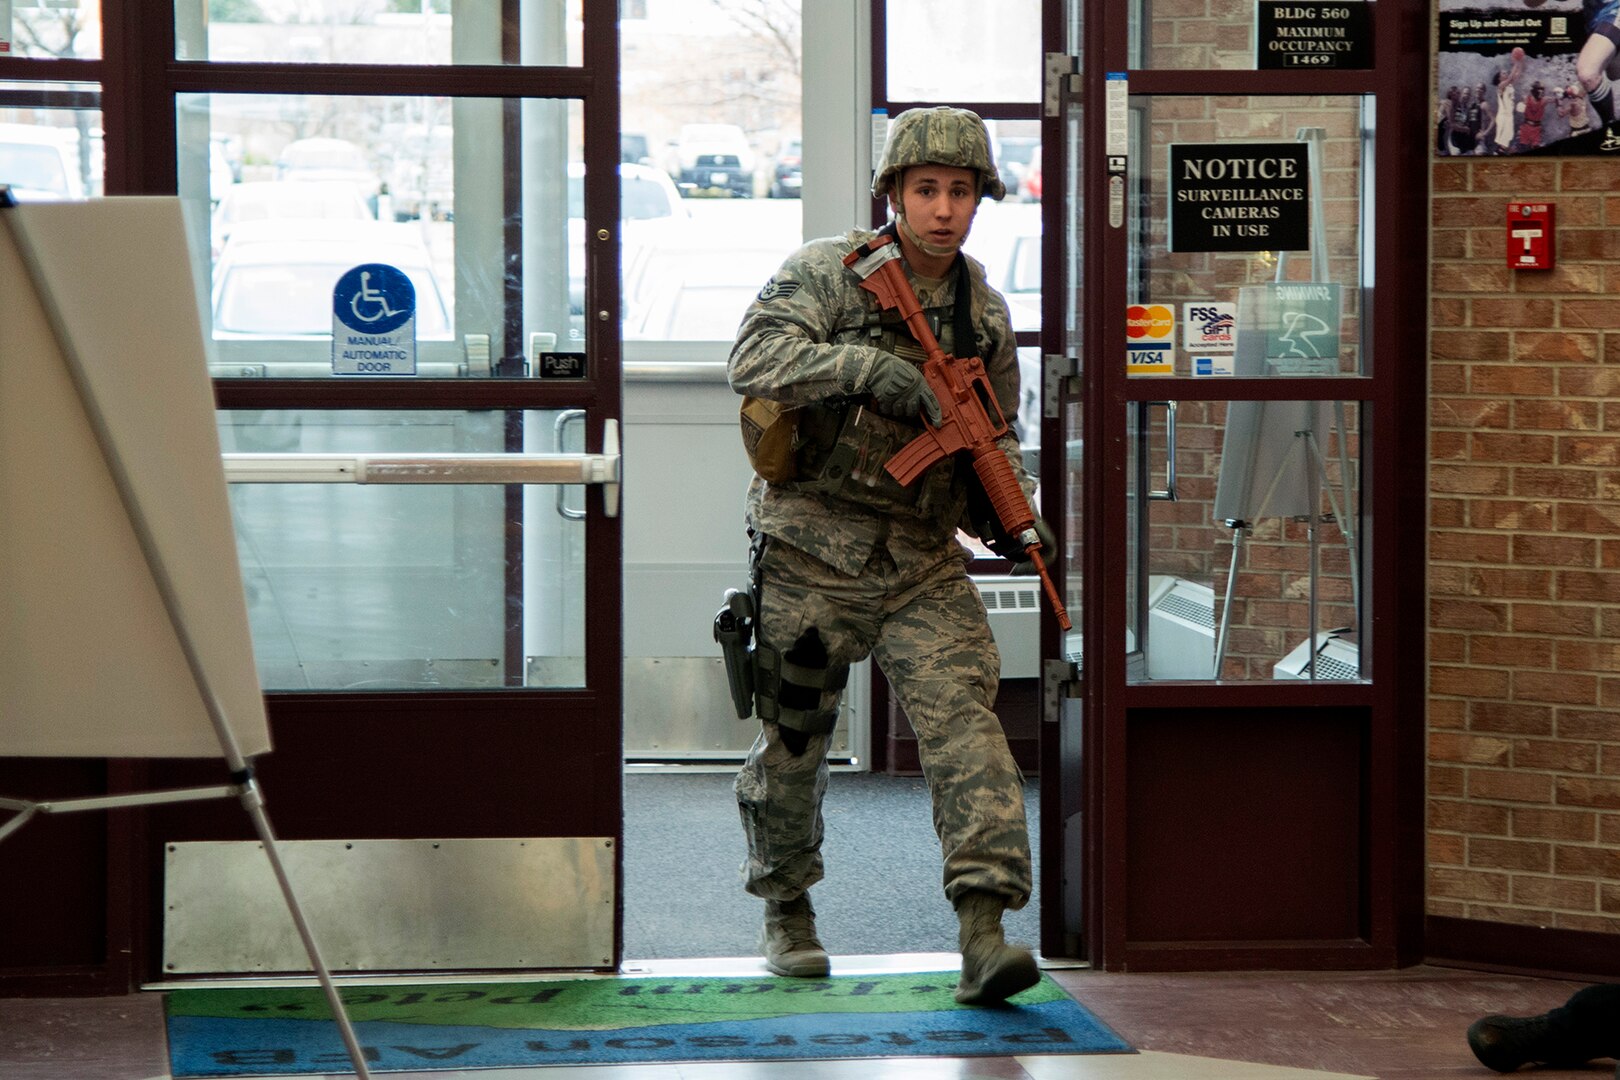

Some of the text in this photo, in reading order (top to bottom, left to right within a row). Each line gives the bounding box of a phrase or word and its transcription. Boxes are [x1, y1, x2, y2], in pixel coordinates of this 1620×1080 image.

[1274, 7, 1350, 19] BLDG 560
[1450, 18, 1542, 29] Sign Up and Stand Out
[1276, 27, 1345, 37] MAXIMUM
[1268, 40, 1354, 51] OCCUPANCY
[1292, 54, 1330, 64] 1469
[1182, 158, 1298, 180] NOTICE
[1177, 188, 1304, 202] SURVEILLANCE
[1201, 206, 1280, 219] CAMERAS
[1212, 224, 1270, 237] IN USE
[1190, 306, 1219, 322] FSS
[342, 350, 408, 360] AUTOMATIC
[1131, 352, 1164, 365] VISA
[356, 362, 391, 372] DOOR
[545, 355, 579, 369] Push
[211, 1028, 1074, 1066] Peterson AFB
